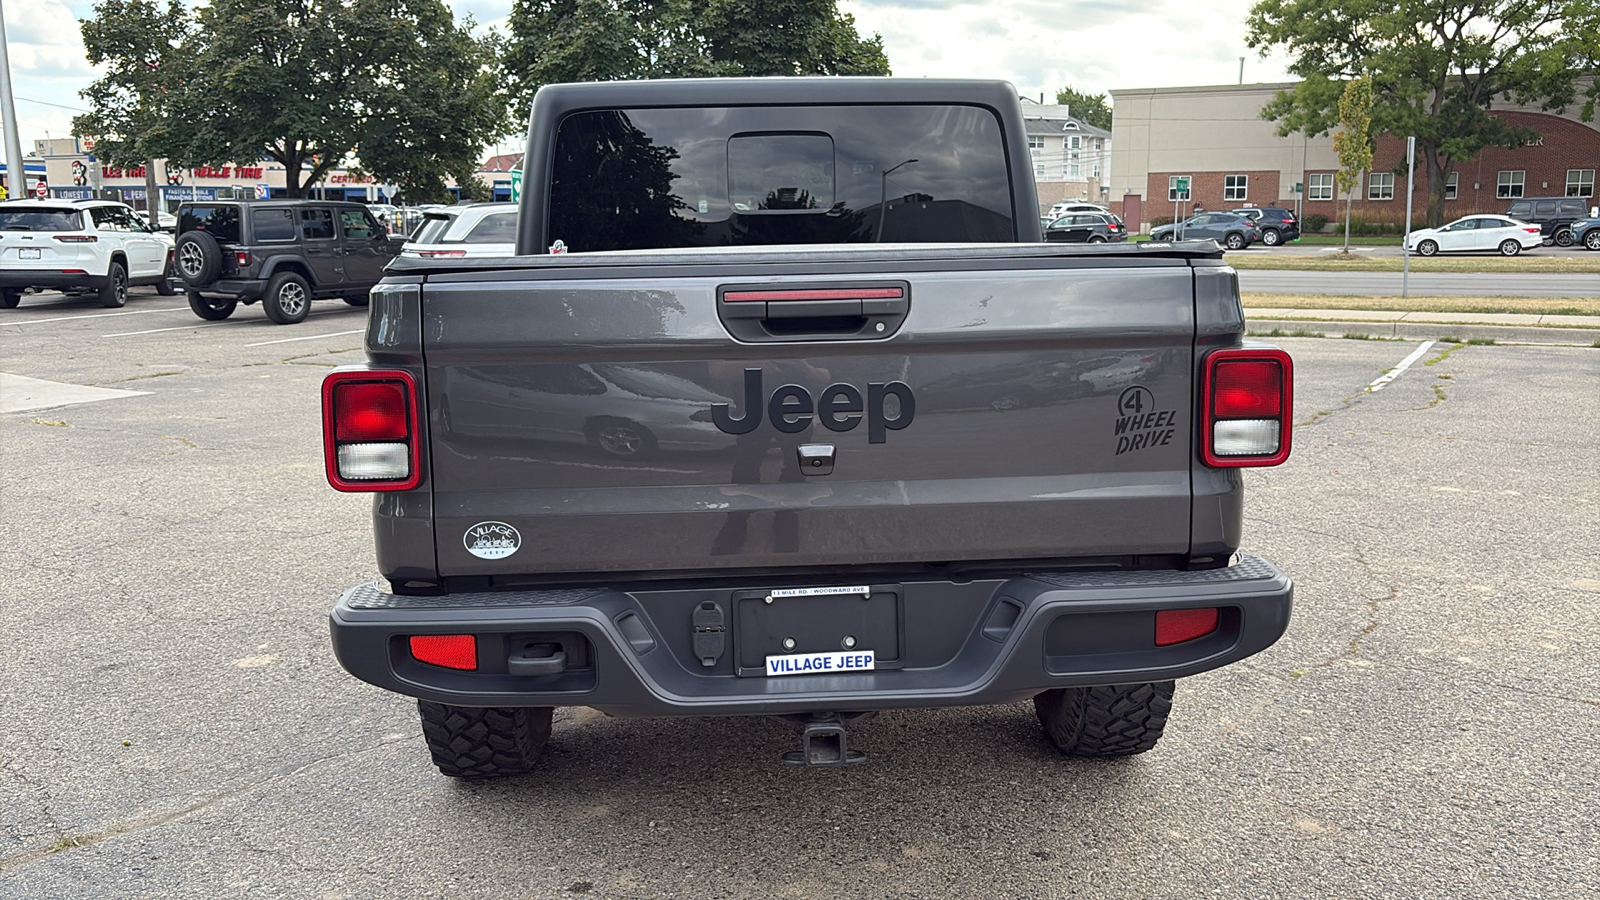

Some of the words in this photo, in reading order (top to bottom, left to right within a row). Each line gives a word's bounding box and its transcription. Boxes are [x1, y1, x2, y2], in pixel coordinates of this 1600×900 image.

[234, 167, 263, 179] TIRE
[60, 190, 84, 199] LOWEST
[711, 367, 916, 444] Jeep
[1124, 390, 1143, 413] 4
[1115, 410, 1176, 436] WHEEL
[1115, 429, 1175, 455] DRIVE
[470, 525, 514, 538] VILLAGE
[770, 657, 832, 672] VILLAGE
[837, 655, 872, 668] JEEP
